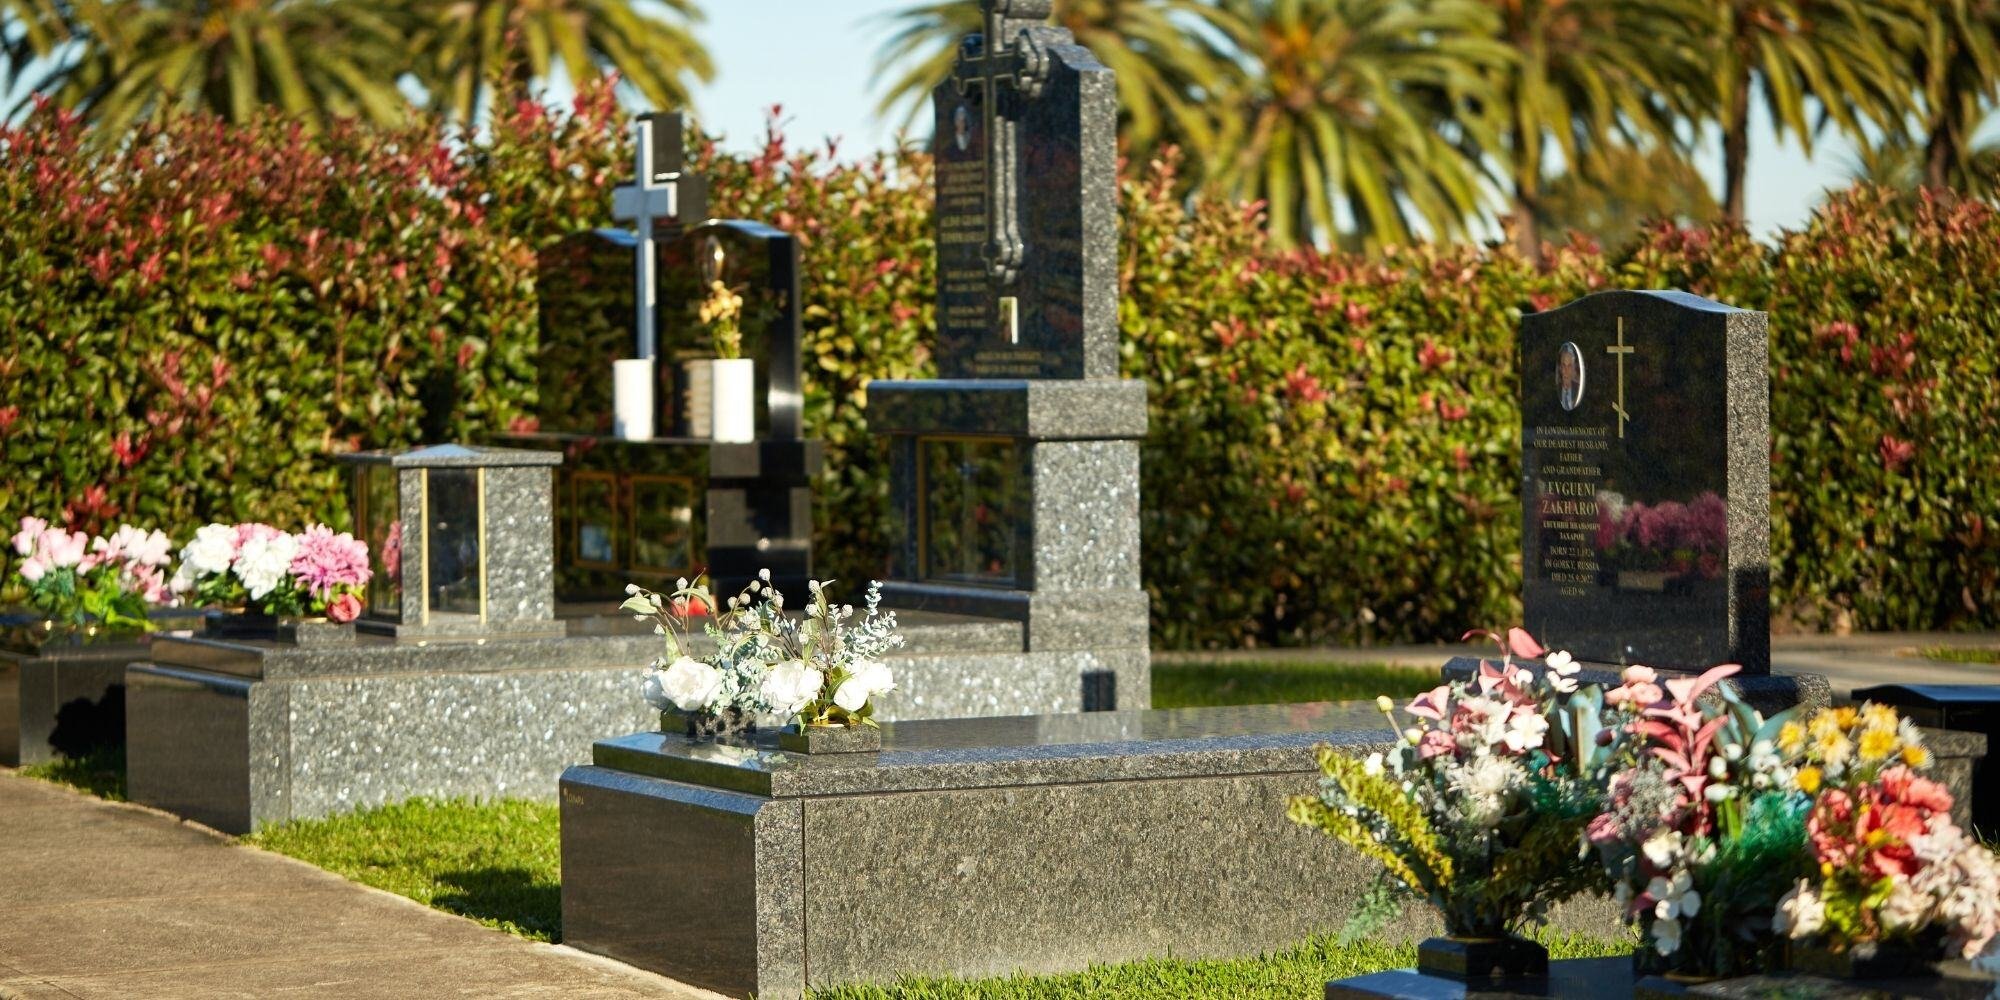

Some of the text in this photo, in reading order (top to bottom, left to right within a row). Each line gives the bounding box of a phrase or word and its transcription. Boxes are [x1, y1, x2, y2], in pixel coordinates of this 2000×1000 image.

[1536, 426, 1606, 436] IN LOVING MEMORY OF
[1533, 440, 1547, 448] OUR
[1548, 440, 1576, 449] DEAREST
[1559, 453, 1583, 462] FATHER
[1543, 466, 1601, 476] AND GRANDFATHER
[1548, 481, 1595, 496] EVGUENI
[1543, 500, 1600, 516] ZAKHAROV
[1549, 546, 1567, 556] BORN
[1544, 559, 1552, 567] IN
[1577, 561, 1600, 571] RUSSIA
[1551, 572, 1567, 582] DIED
[1561, 587, 1577, 596] AGED
